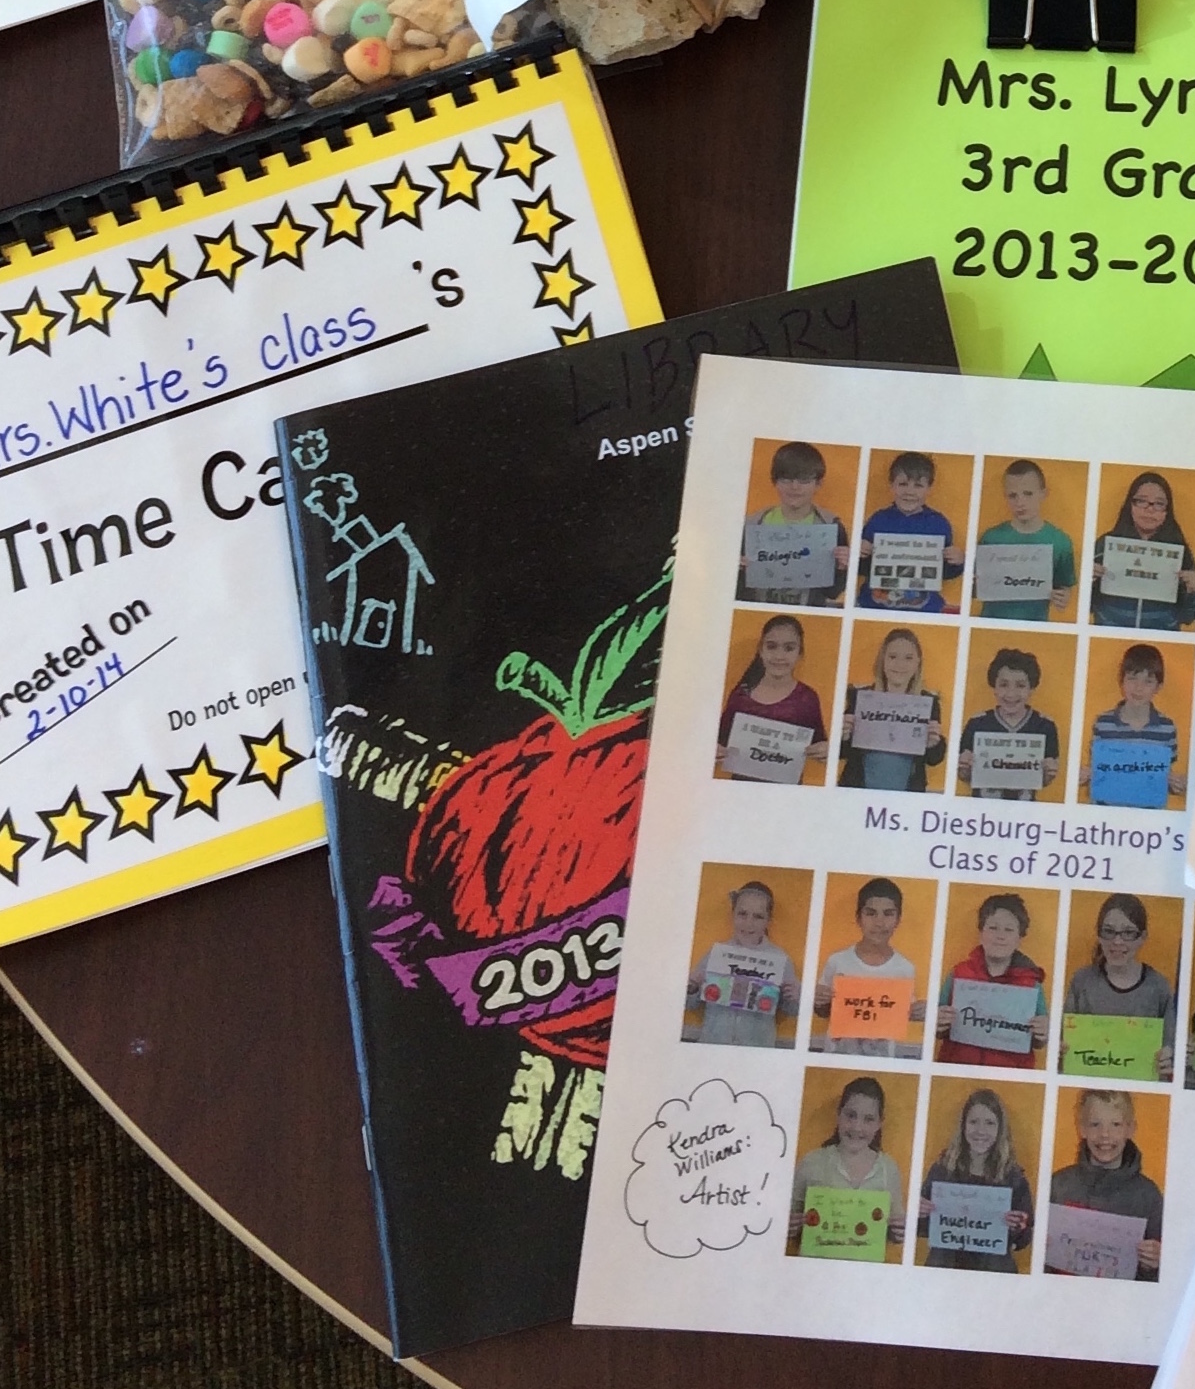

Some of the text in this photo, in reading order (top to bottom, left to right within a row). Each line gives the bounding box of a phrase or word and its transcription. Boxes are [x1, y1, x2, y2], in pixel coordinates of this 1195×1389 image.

[937, 58, 1072, 111] Mrs.
[962, 143, 1068, 194] 3rd
[260, 306, 377, 372] class
[597, 425, 679, 460] Aspen
[0, 597, 153, 716] reated on
[26, 652, 125, 742] 2-10-14
[168, 674, 297, 733] Do not open
[864, 806, 1186, 853] Ms. Diesburg-Lathrop's
[928, 844, 1114, 881] Class of 2021
[478, 921, 623, 1010] 2013
[1074, 1049, 1135, 1068] Teacher
[667, 1123, 735, 1159] Kendra
[674, 1134, 752, 1177] Williams:
[941, 1231, 1004, 1250] Engineer
